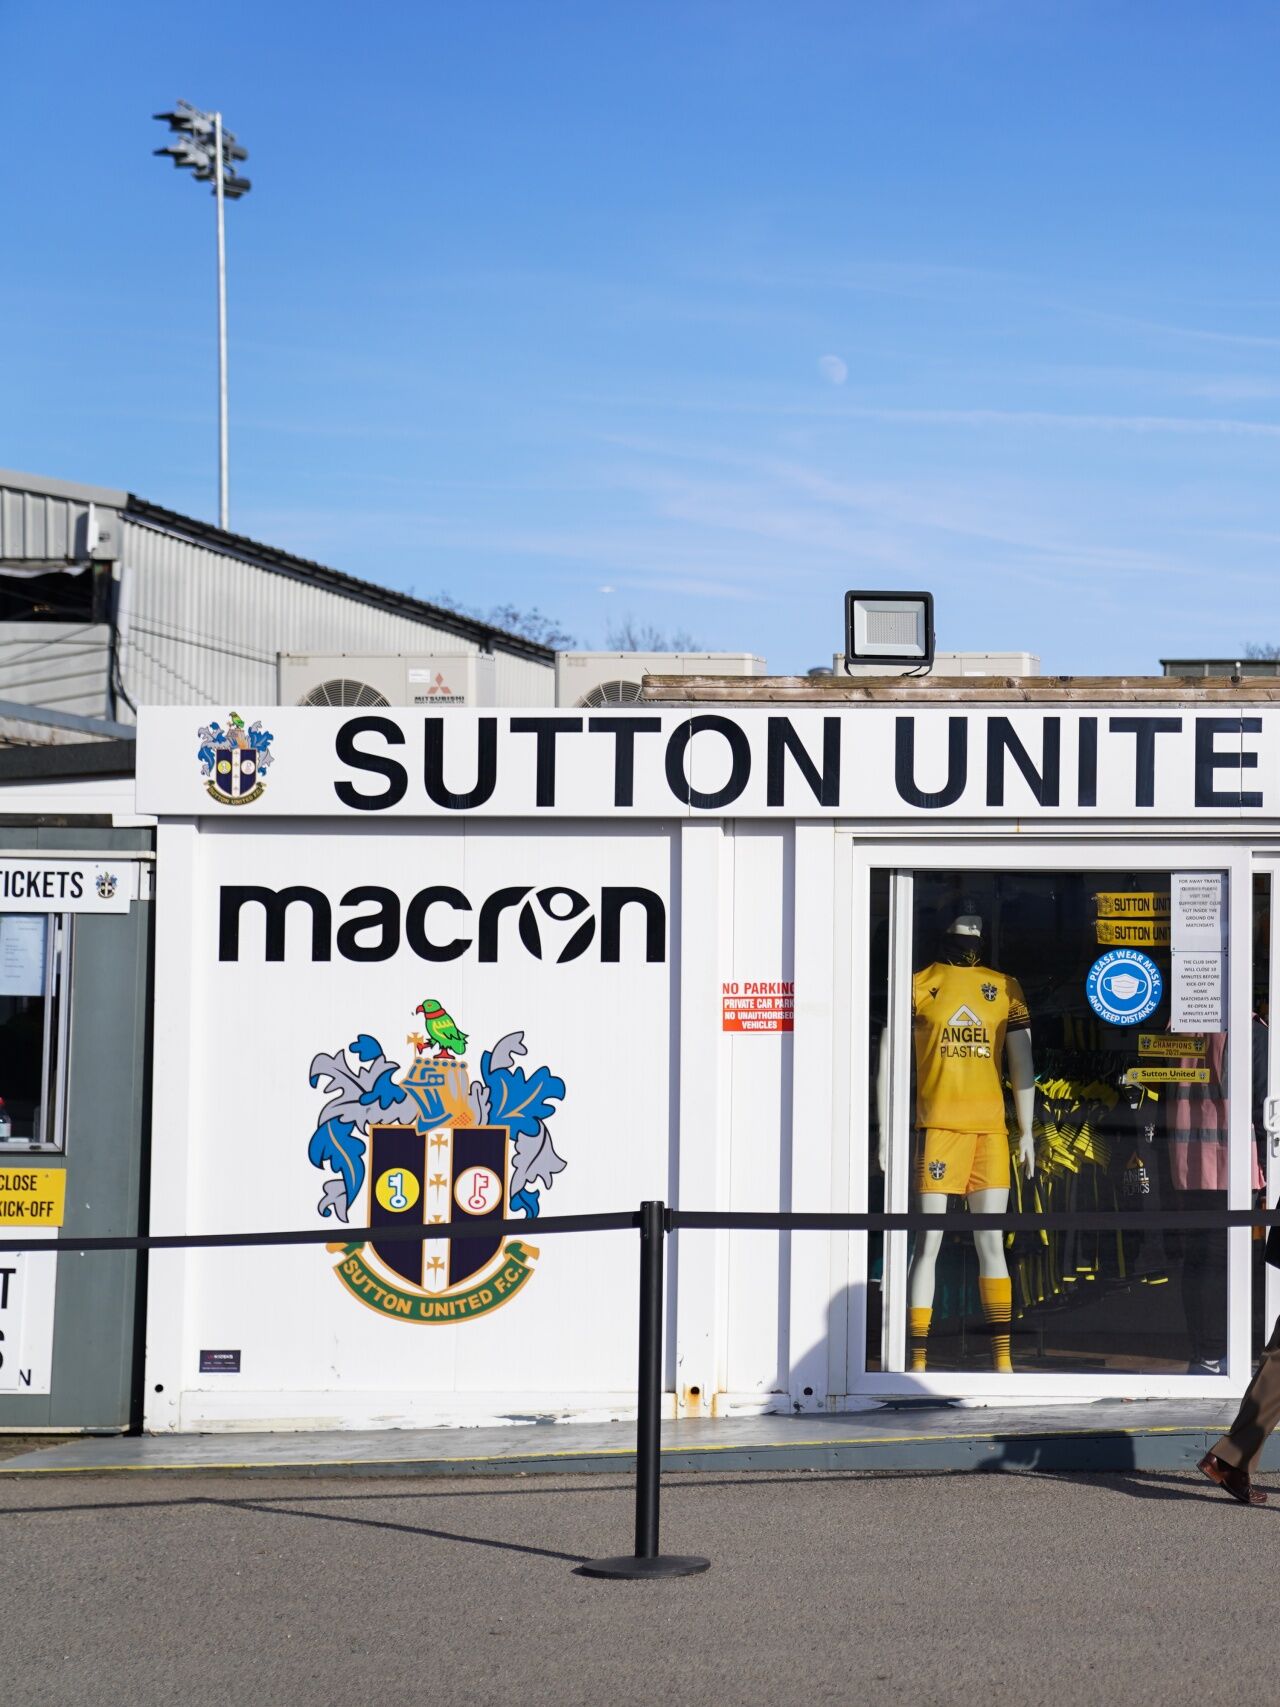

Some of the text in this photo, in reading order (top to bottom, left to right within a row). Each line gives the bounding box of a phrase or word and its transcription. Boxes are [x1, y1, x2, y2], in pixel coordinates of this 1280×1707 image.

[333, 714, 842, 812] SUTTON
[0, 870, 84, 898] ICKETS
[1114, 897, 1150, 911] SUTTON
[218, 885, 667, 964] macron
[1114, 925, 1150, 940] SUTTON
[1090, 950, 1160, 987] PLEASE WEAR MASK
[722, 982, 739, 994] NO
[724, 998, 794, 1009] PRIVATE CAR PARK
[1089, 995, 1156, 1023] AND KEEP DISTANCE
[724, 1011, 794, 1020] NO UNAUTHORISED
[742, 1020, 778, 1029] VEHICLES
[940, 1027, 990, 1043] ANGEL
[940, 1045, 991, 1058] PLASTICS
[1152, 1041, 1192, 1050] CHAMPIONS
[343, 1259, 524, 1317] SUTTON UNITED F.C.
